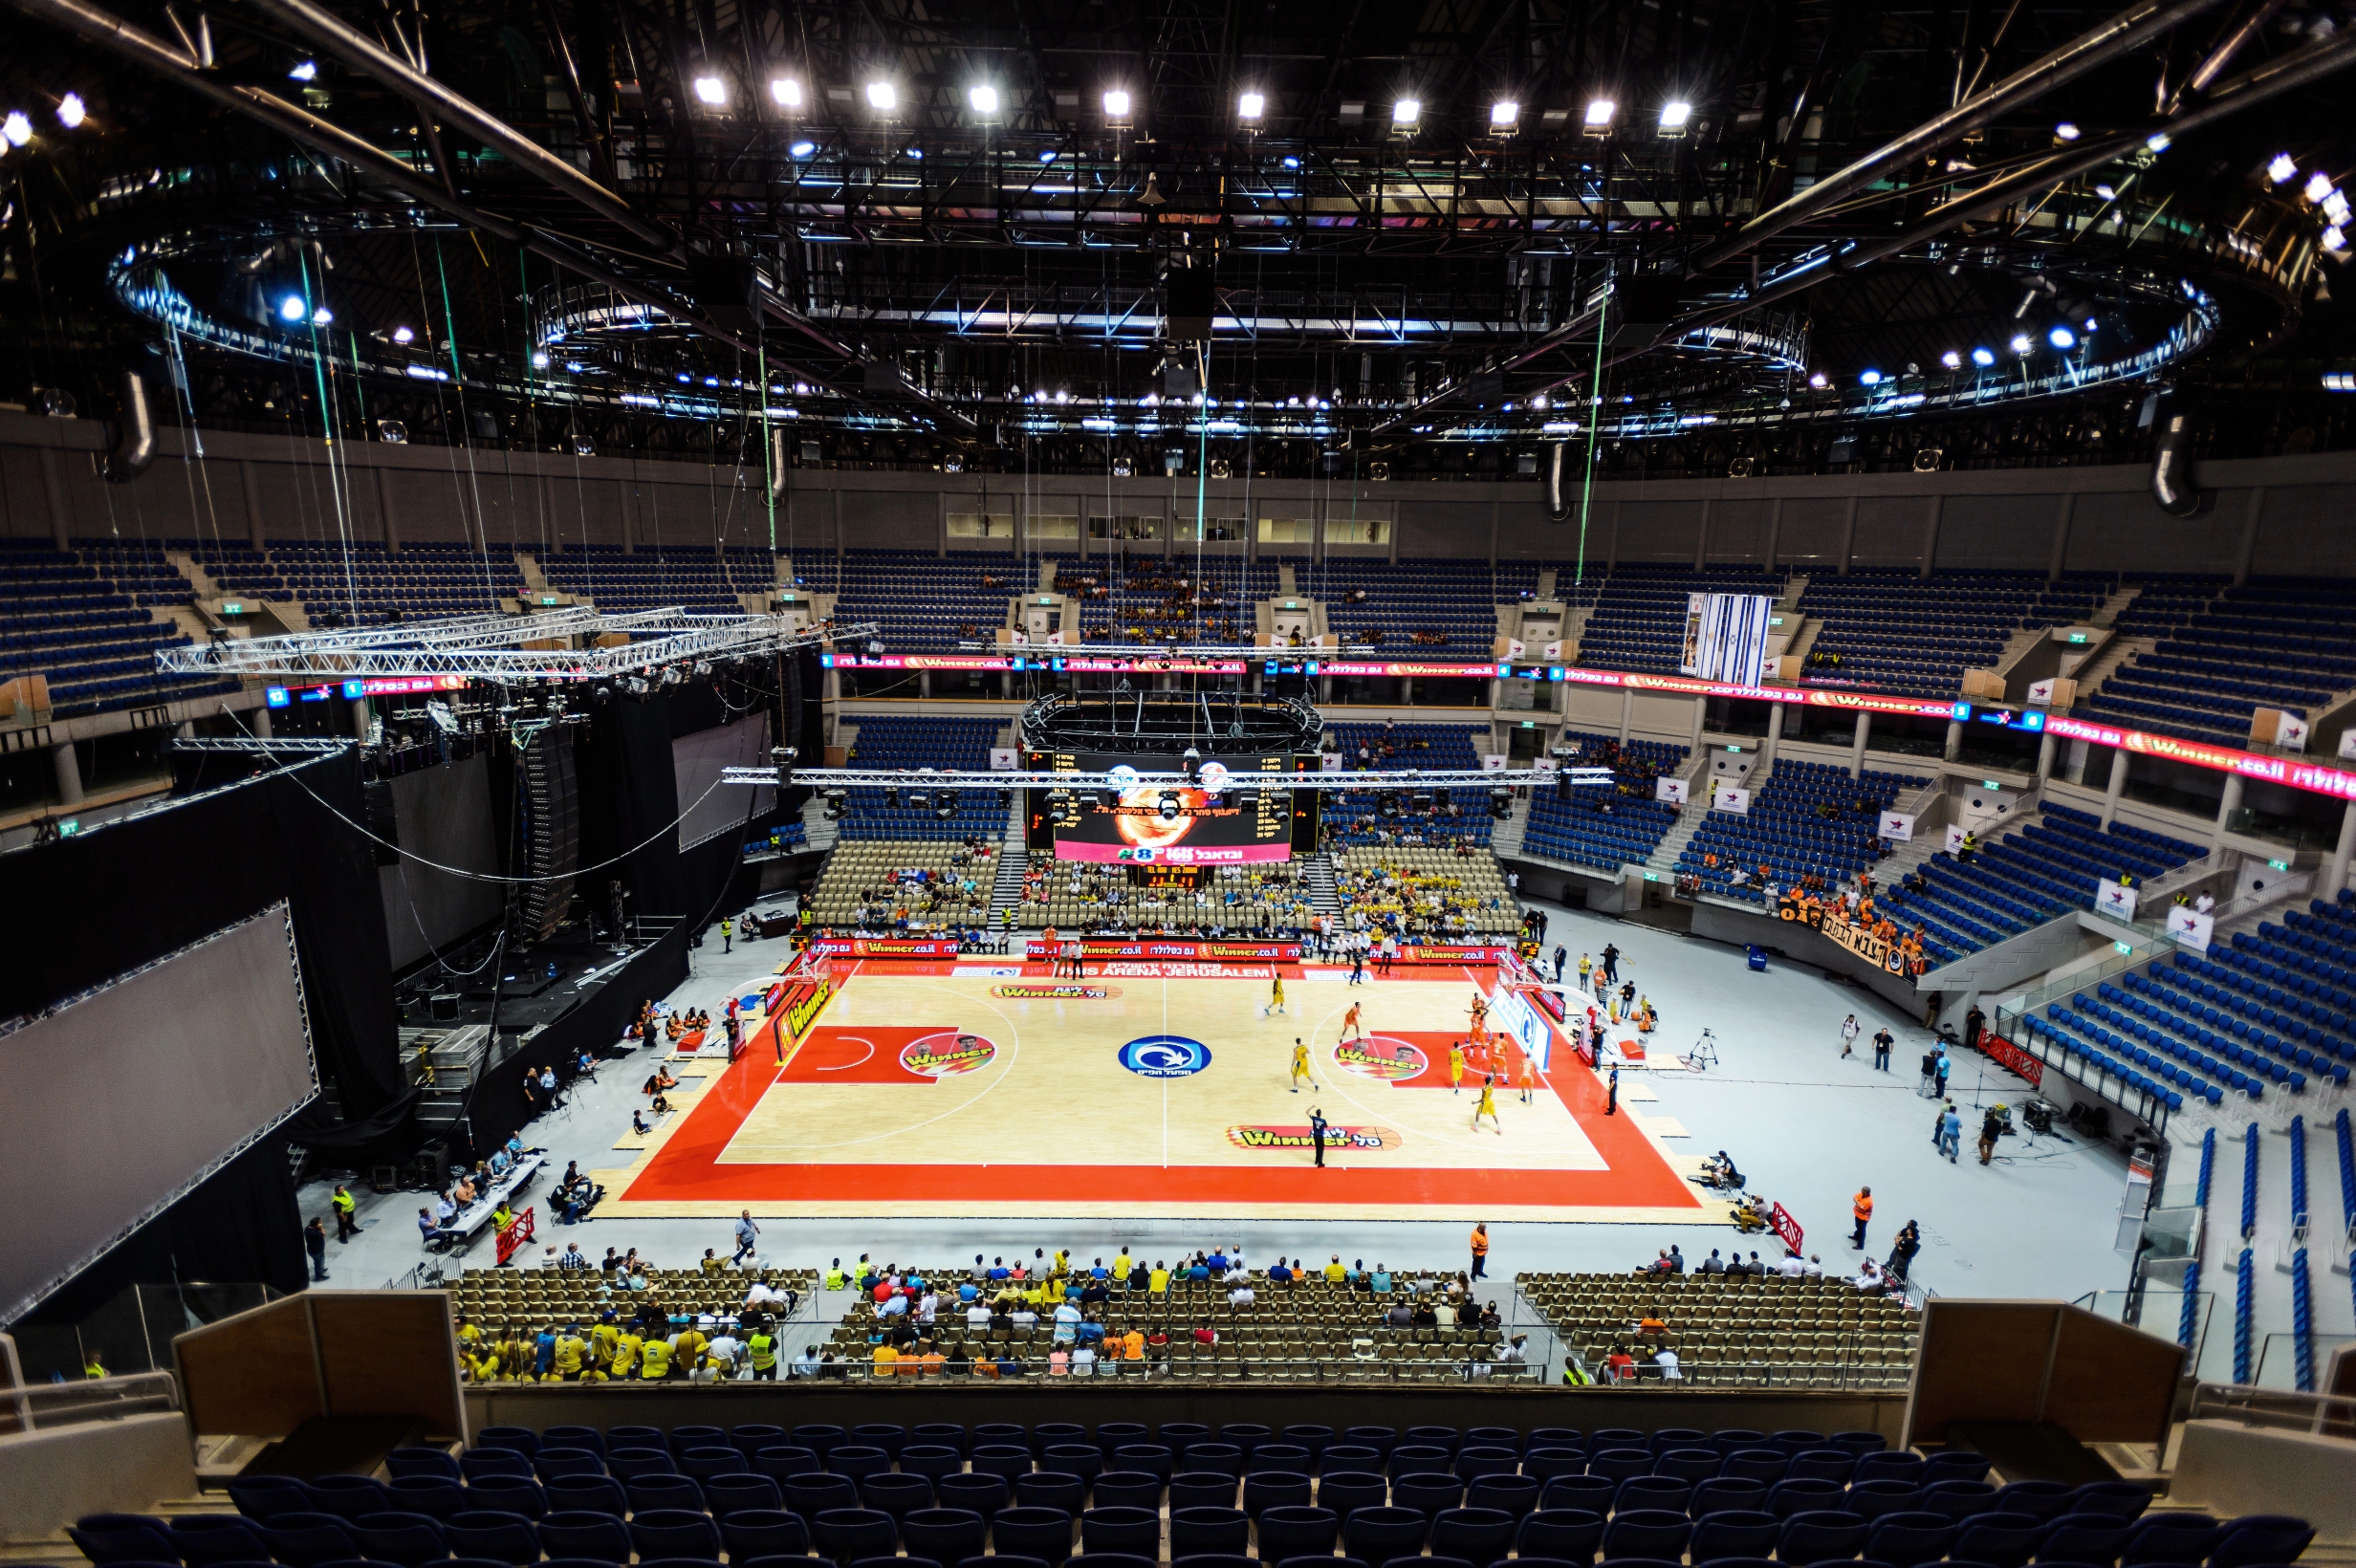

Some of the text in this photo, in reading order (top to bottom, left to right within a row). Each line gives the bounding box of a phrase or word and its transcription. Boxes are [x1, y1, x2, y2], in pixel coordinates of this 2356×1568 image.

[1405, 665, 1494, 675] Winner.co.il
[2151, 739, 2284, 778] Winner.co.il
[867, 942, 936, 954] Winner.co.il
[1184, 947, 1195, 956] גם
[1211, 945, 1279, 957] Winner.co.il
[1419, 948, 1485, 960] Winner.co.il
[1102, 967, 1162, 977] ARENA
[1165, 968, 1270, 978] JERUSALEM
[1002, 987, 1084, 998] Winner
[1085, 990, 1107, 998] סל
[789, 979, 830, 1039] Winner
[904, 1047, 994, 1066] Winner
[1337, 1047, 1424, 1071] Winner
[1242, 1130, 1352, 1147] Winner
[1311, 1127, 1347, 1139] ליג
[1351, 1133, 1382, 1147] סל
